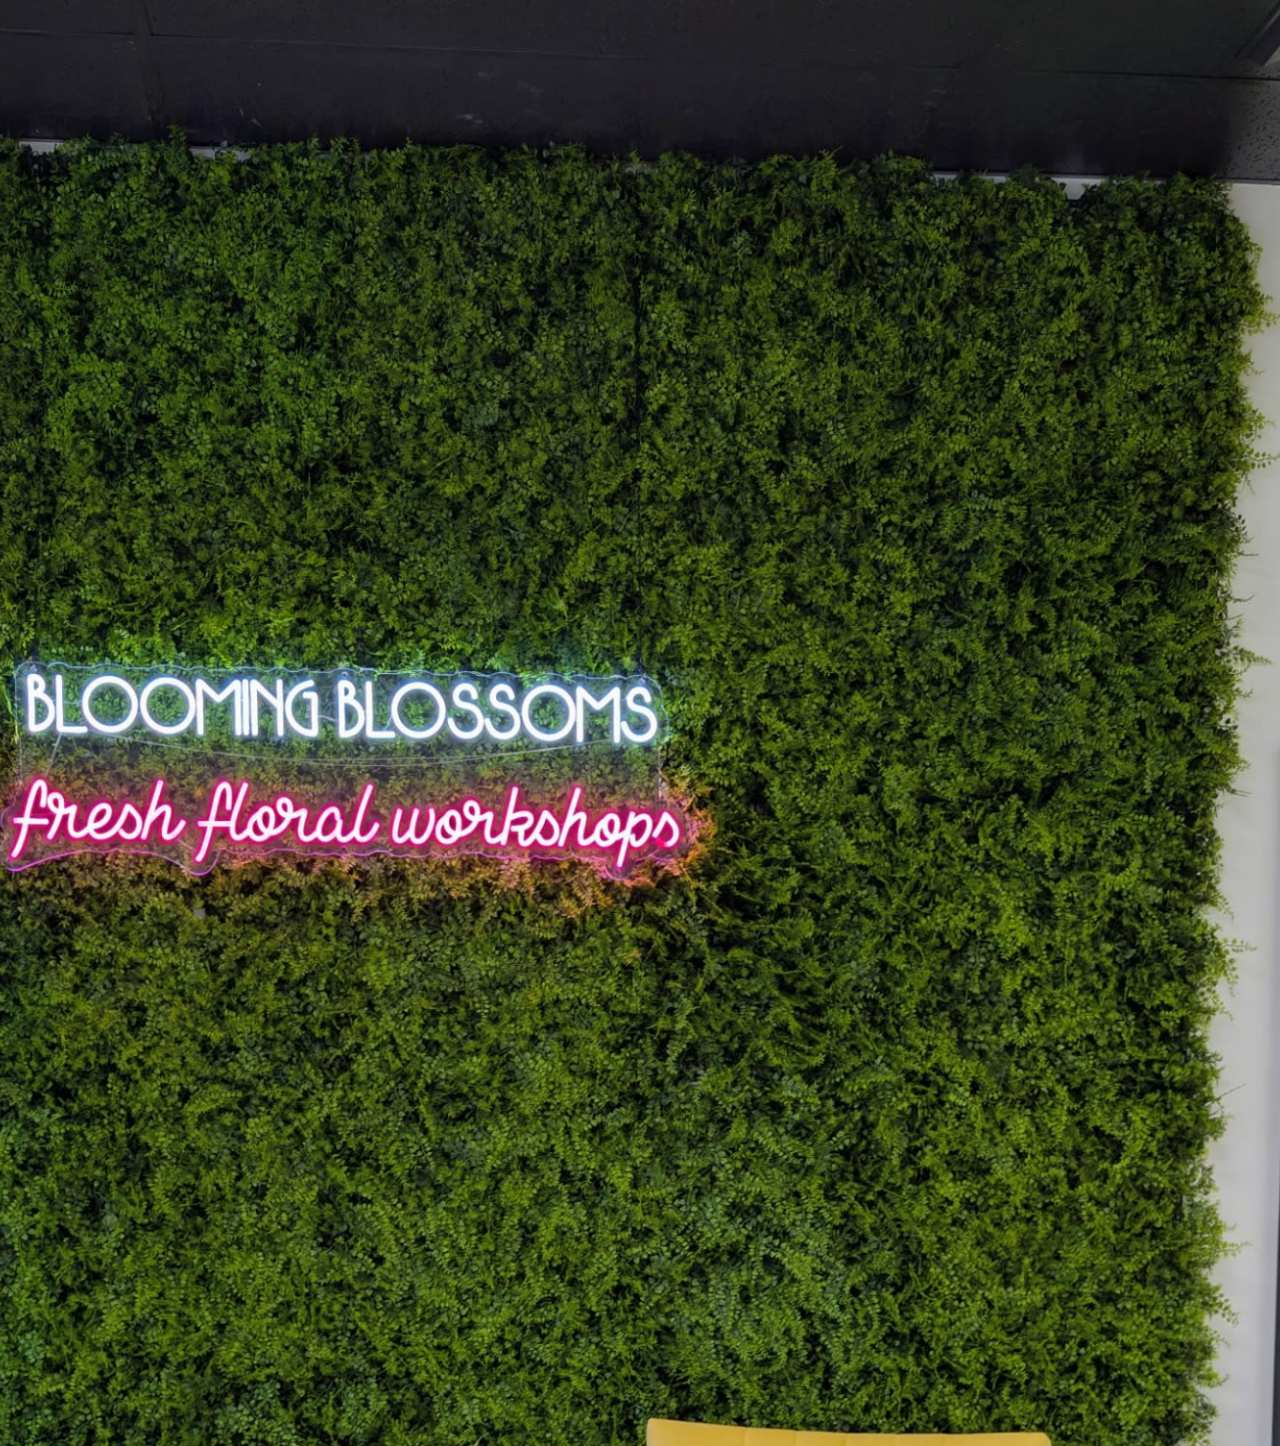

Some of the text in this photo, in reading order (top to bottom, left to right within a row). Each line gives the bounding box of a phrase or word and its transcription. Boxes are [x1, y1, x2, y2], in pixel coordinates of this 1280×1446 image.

[23, 672, 659, 744] BLOOMING BLOSSOMS
[8, 777, 683, 868] fresh floral workshops
